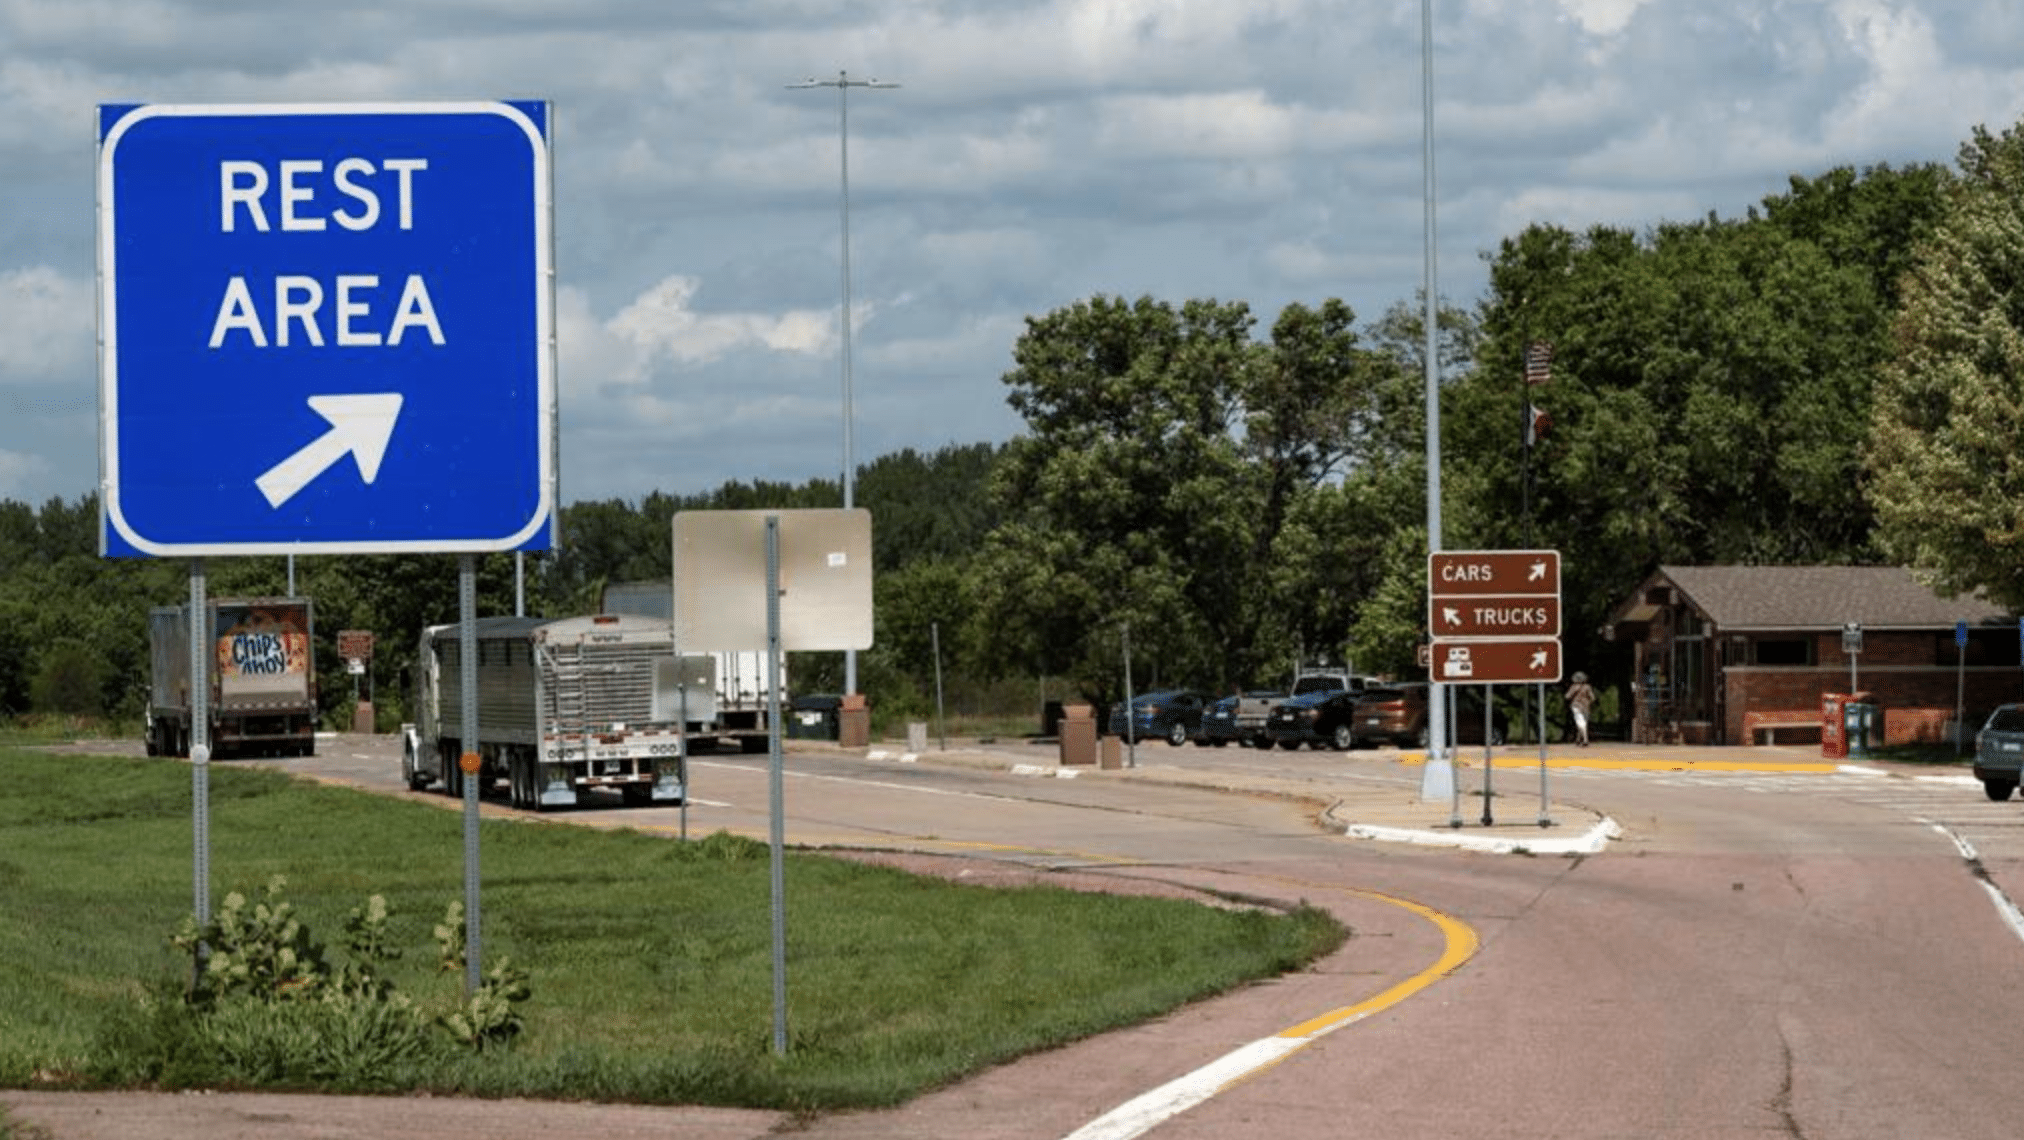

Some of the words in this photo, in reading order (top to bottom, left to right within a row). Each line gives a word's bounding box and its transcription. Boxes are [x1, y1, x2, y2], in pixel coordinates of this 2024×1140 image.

[220, 157, 429, 232] REST
[208, 274, 446, 348] AREA
[1441, 563, 1493, 582] CARS
[1473, 607, 1548, 625] TRUCKS
